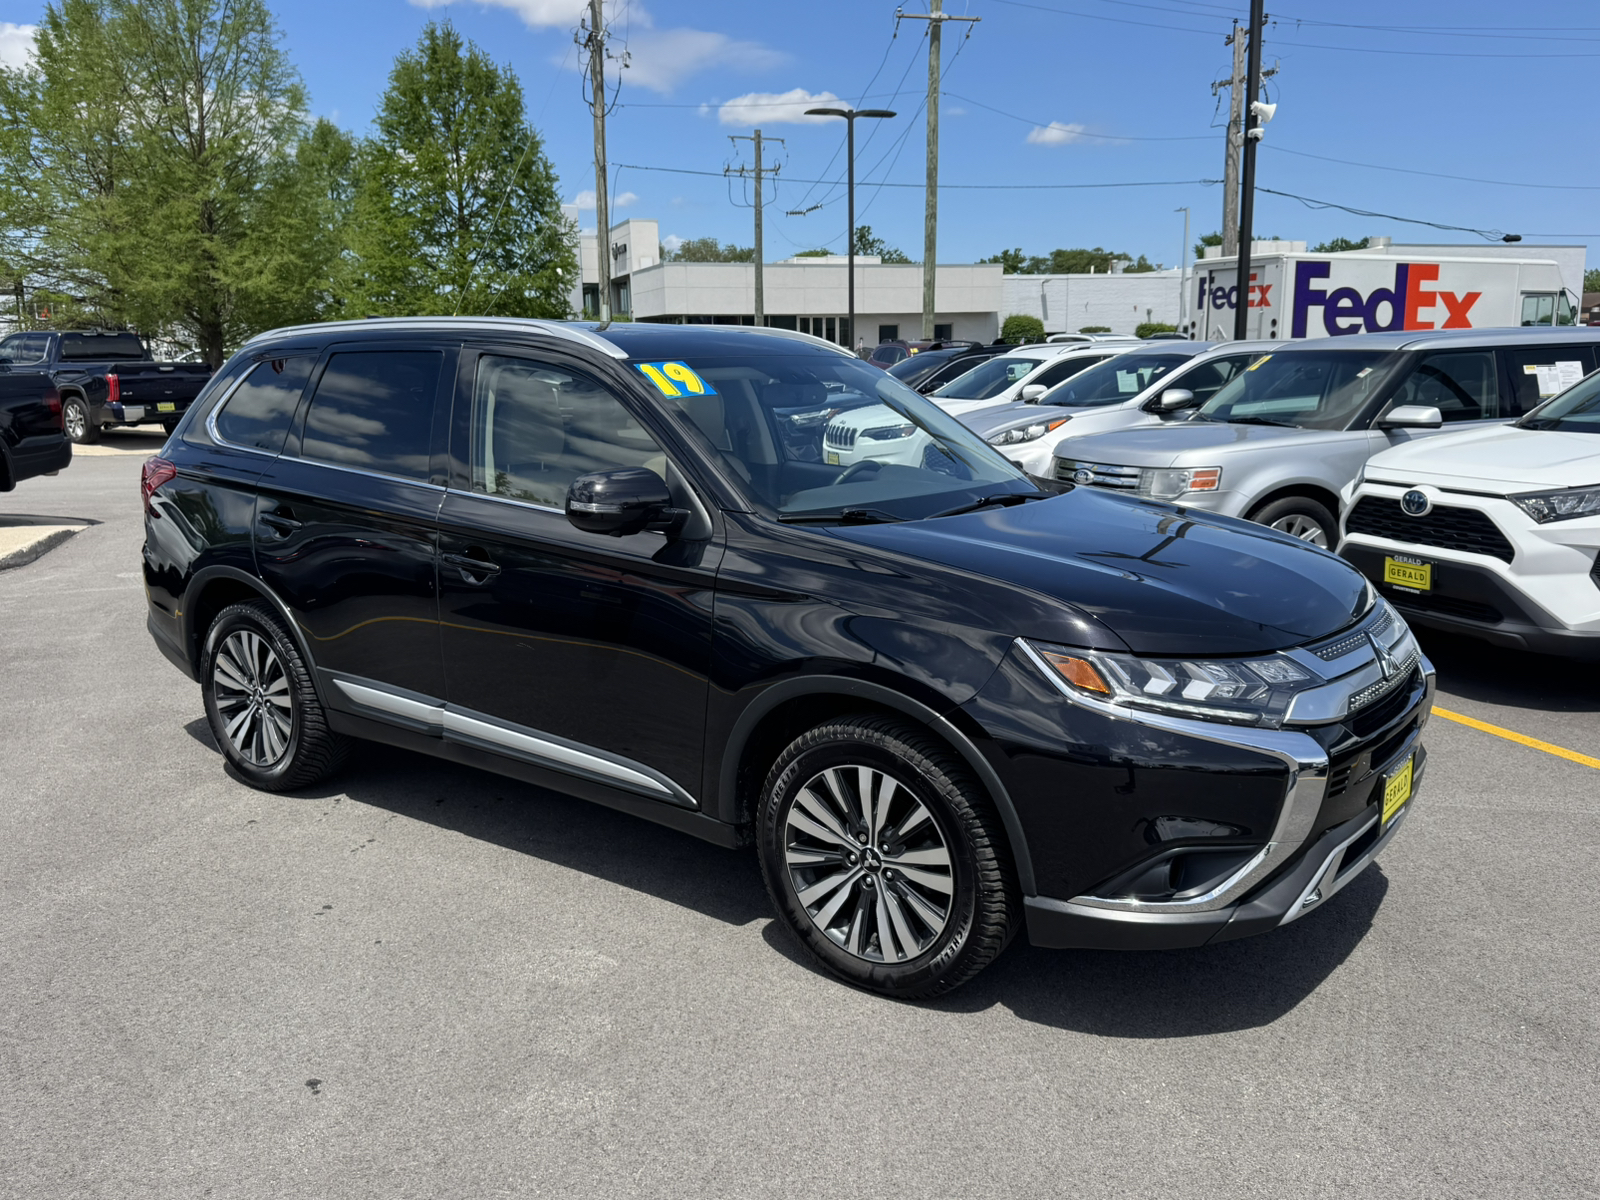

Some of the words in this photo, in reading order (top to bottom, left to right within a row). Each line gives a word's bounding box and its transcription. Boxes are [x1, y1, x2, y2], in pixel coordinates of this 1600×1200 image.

[1291, 261, 1483, 338] FedEx
[640, 363, 704, 396] 19
[1390, 567, 1425, 581] GERALD
[1394, 555, 1421, 565] GERALD
[768, 766, 797, 822] MICHELIN
[1385, 774, 1408, 806] GERALD
[934, 911, 969, 972] MICHELIN
